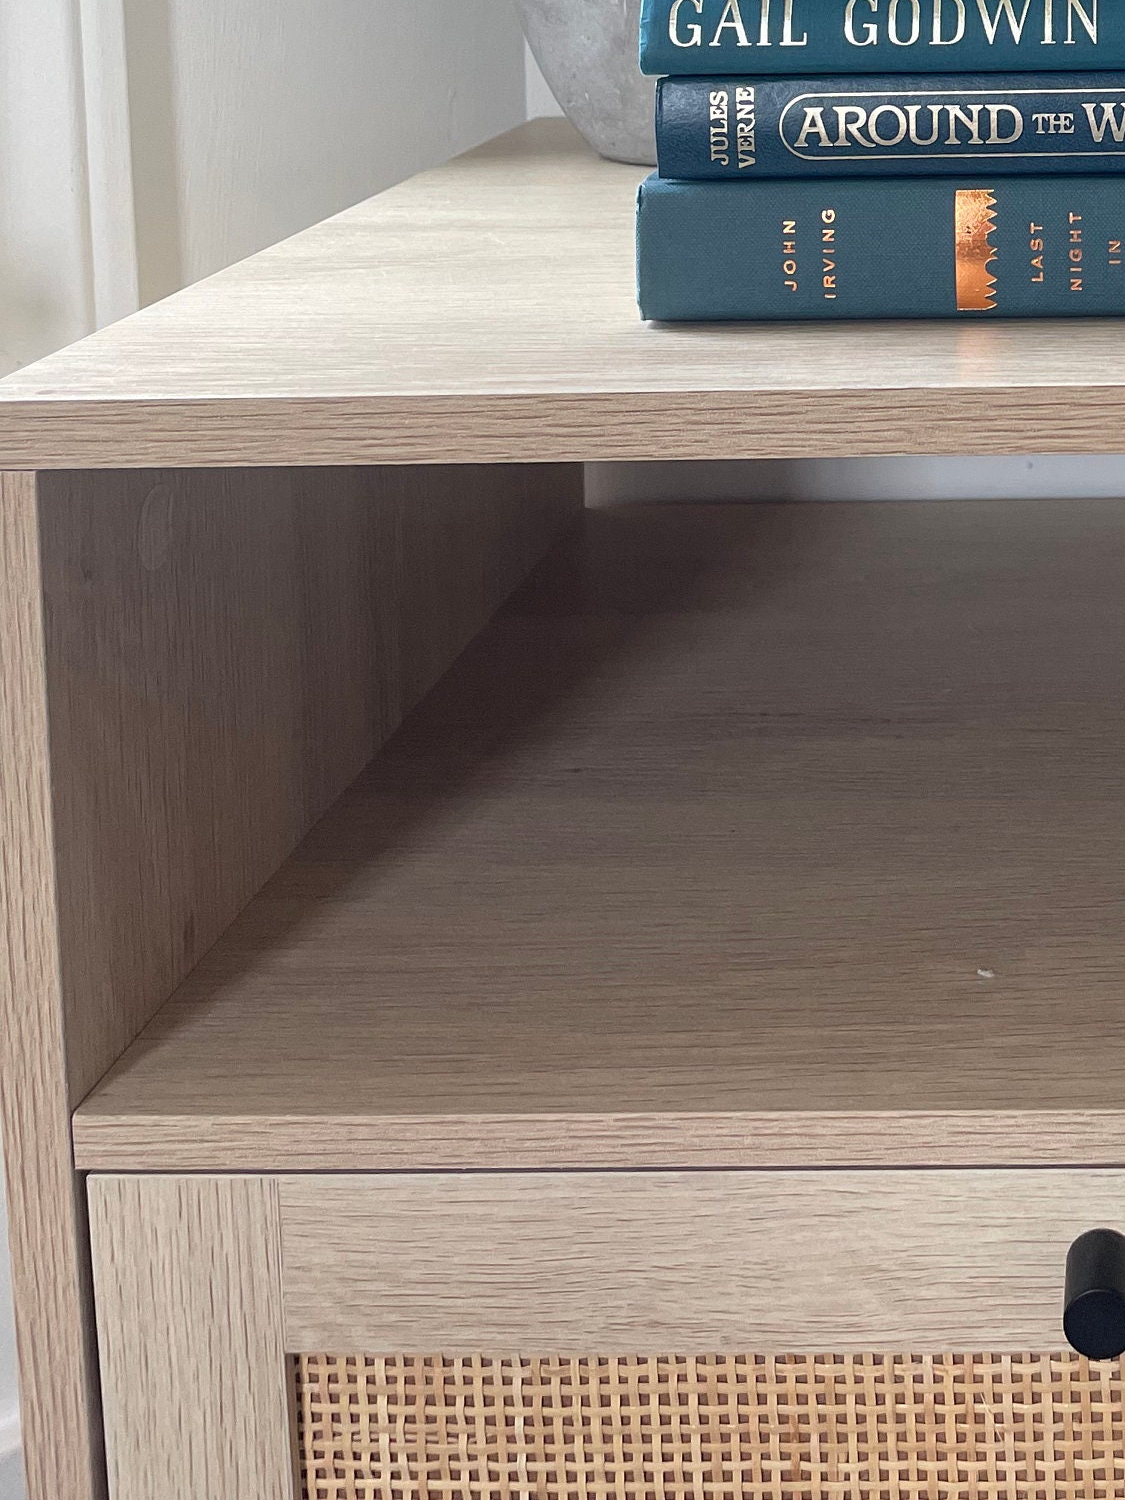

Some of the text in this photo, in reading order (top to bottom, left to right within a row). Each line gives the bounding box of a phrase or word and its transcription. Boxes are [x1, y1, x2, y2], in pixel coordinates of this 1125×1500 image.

[708, 90, 729, 166] JULES
[735, 86, 756, 169] VERNE
[794, 103, 1023, 148] AROUND
[1031, 112, 1075, 134] THE
[782, 220, 798, 292] JOHN
[821, 210, 836, 298] IRVING
[1029, 223, 1044, 283] LAST
[1068, 212, 1083, 291] NIGHT
[1108, 239, 1121, 265] IN
